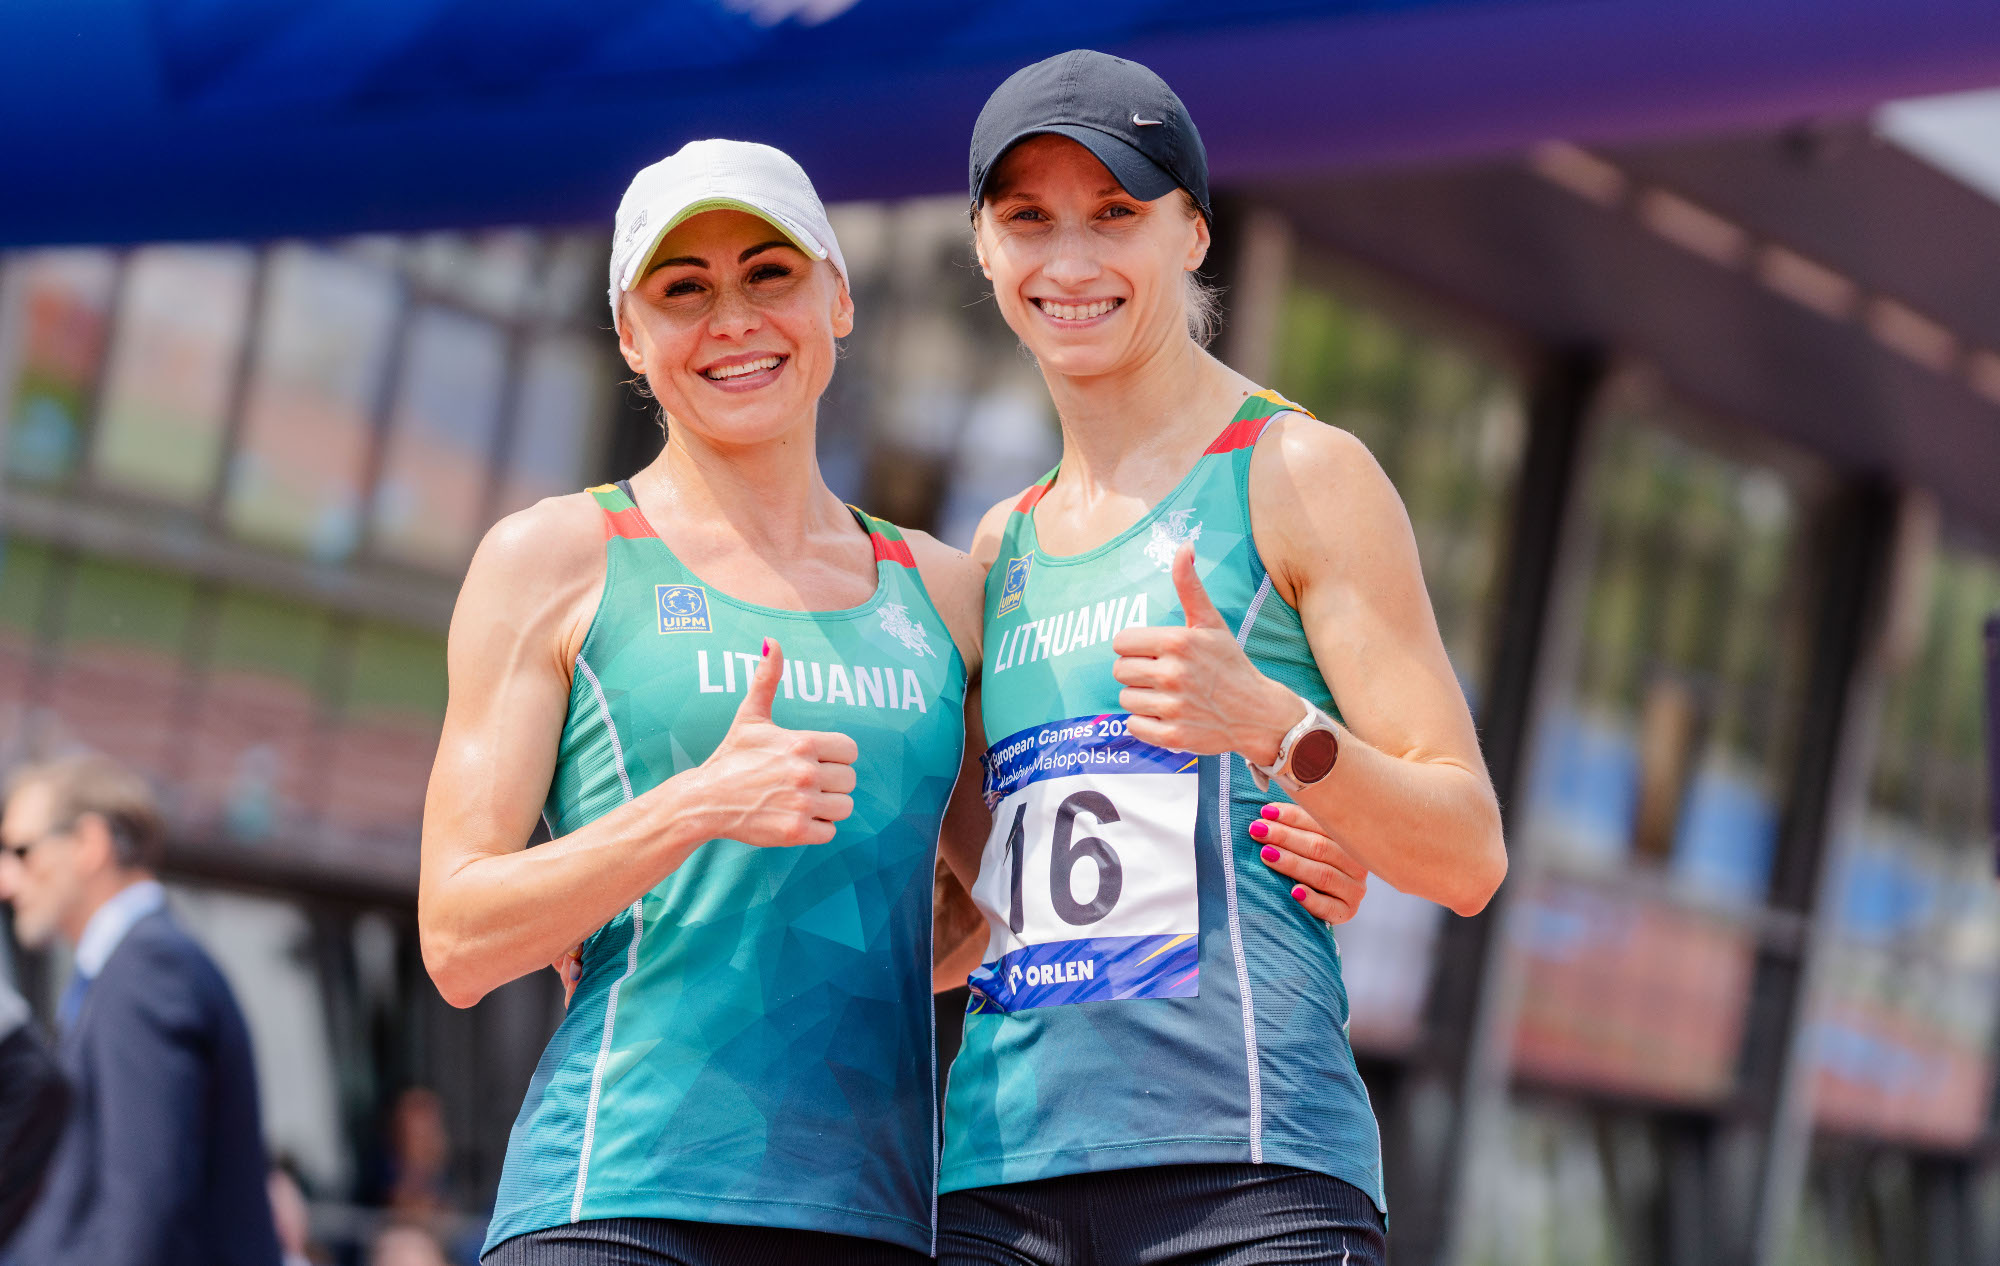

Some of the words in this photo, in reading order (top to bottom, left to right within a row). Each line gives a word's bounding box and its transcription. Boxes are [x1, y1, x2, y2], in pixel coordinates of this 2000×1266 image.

[663, 617, 706, 627] UIPM
[994, 592, 1148, 674] LITHUANIA
[1038, 724, 1093, 746] Games
[1097, 719, 1133, 737] 202
[1003, 789, 1123, 935] 16
[1025, 959, 1094, 987] ORLEN
